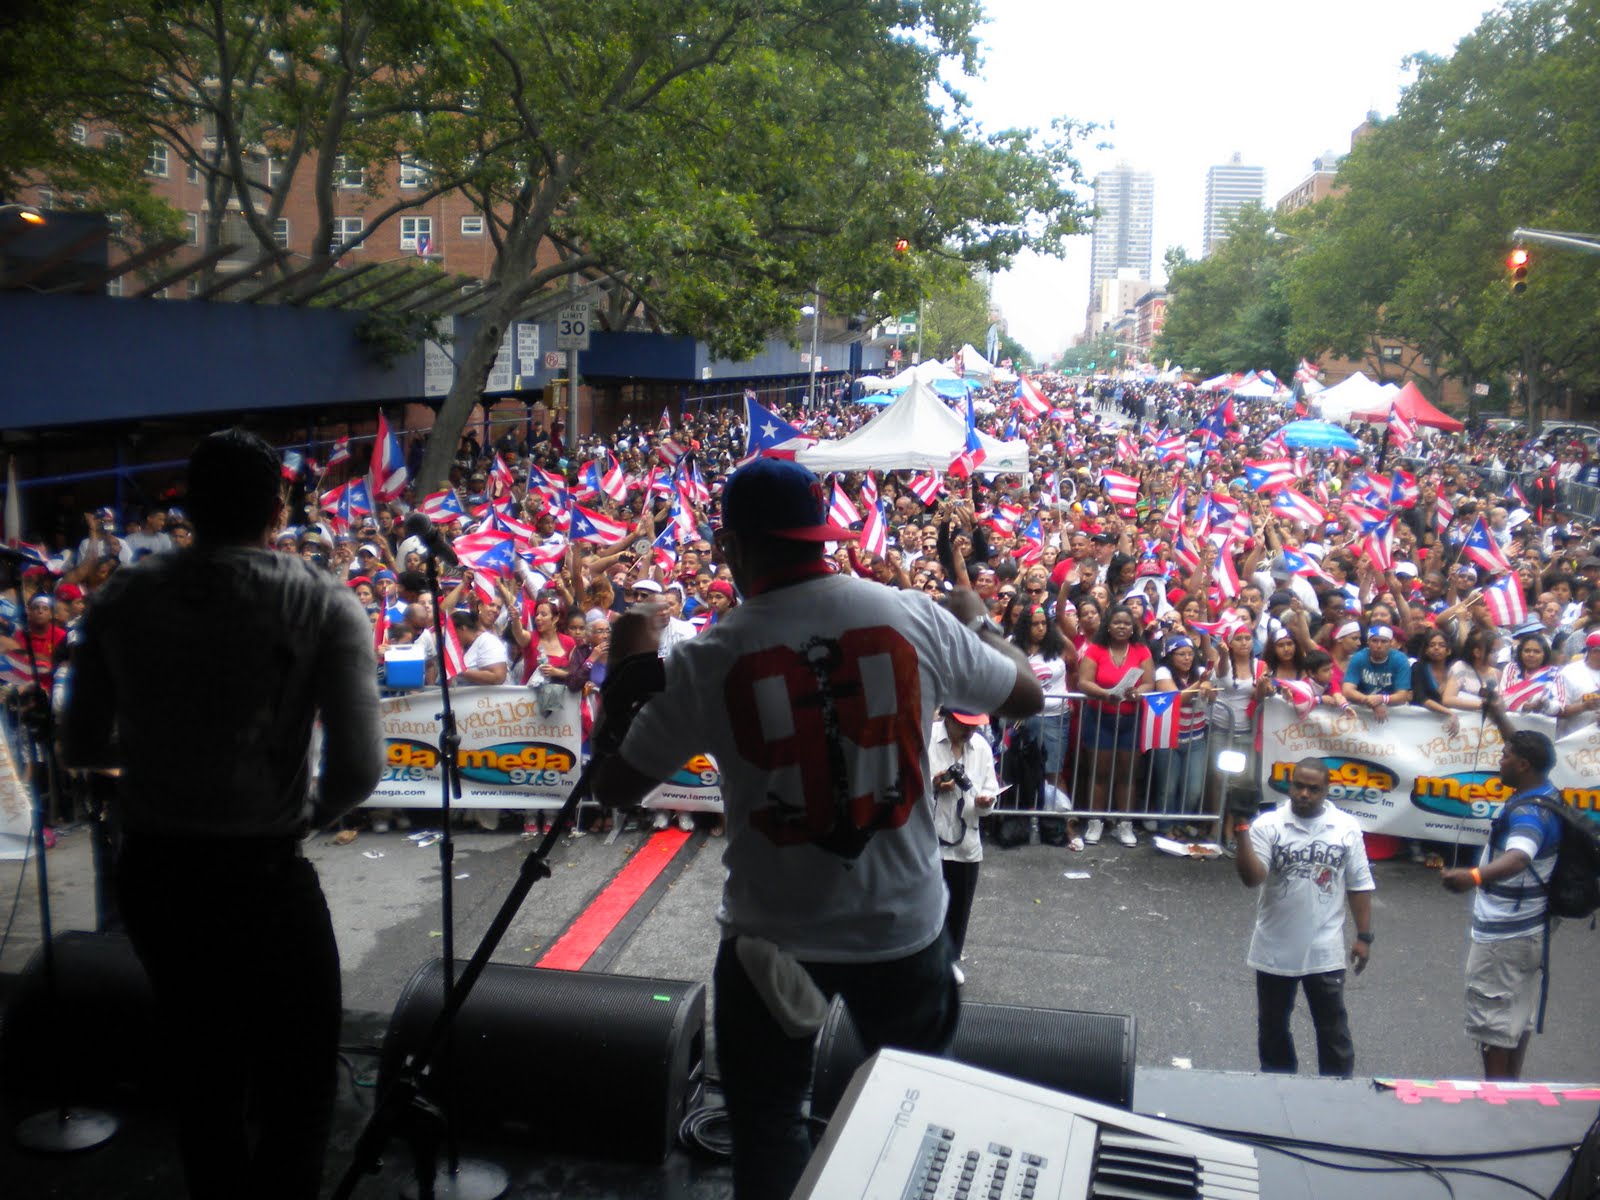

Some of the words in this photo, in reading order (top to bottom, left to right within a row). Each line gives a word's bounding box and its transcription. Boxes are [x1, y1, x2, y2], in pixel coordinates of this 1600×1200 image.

[560, 320, 585, 336] 30
[477, 697, 491, 708] el
[384, 719, 437, 734] ñana
[472, 730, 484, 739] de
[486, 728, 497, 736] la
[498, 722, 574, 738] mañana
[1416, 722, 1505, 758] vaciló
[386, 742, 437, 769] ga
[457, 747, 571, 774] mega
[509, 768, 562, 786] 97.9
[470, 789, 561, 798] www.lamega.com
[662, 791, 721, 802] www.lameg
[1328, 783, 1383, 805] 97.9
[1382, 798, 1395, 808] fm
[1414, 775, 1517, 804] meg
[1471, 800, 1505, 819] 97
[1425, 821, 1490, 835] www.lameg
